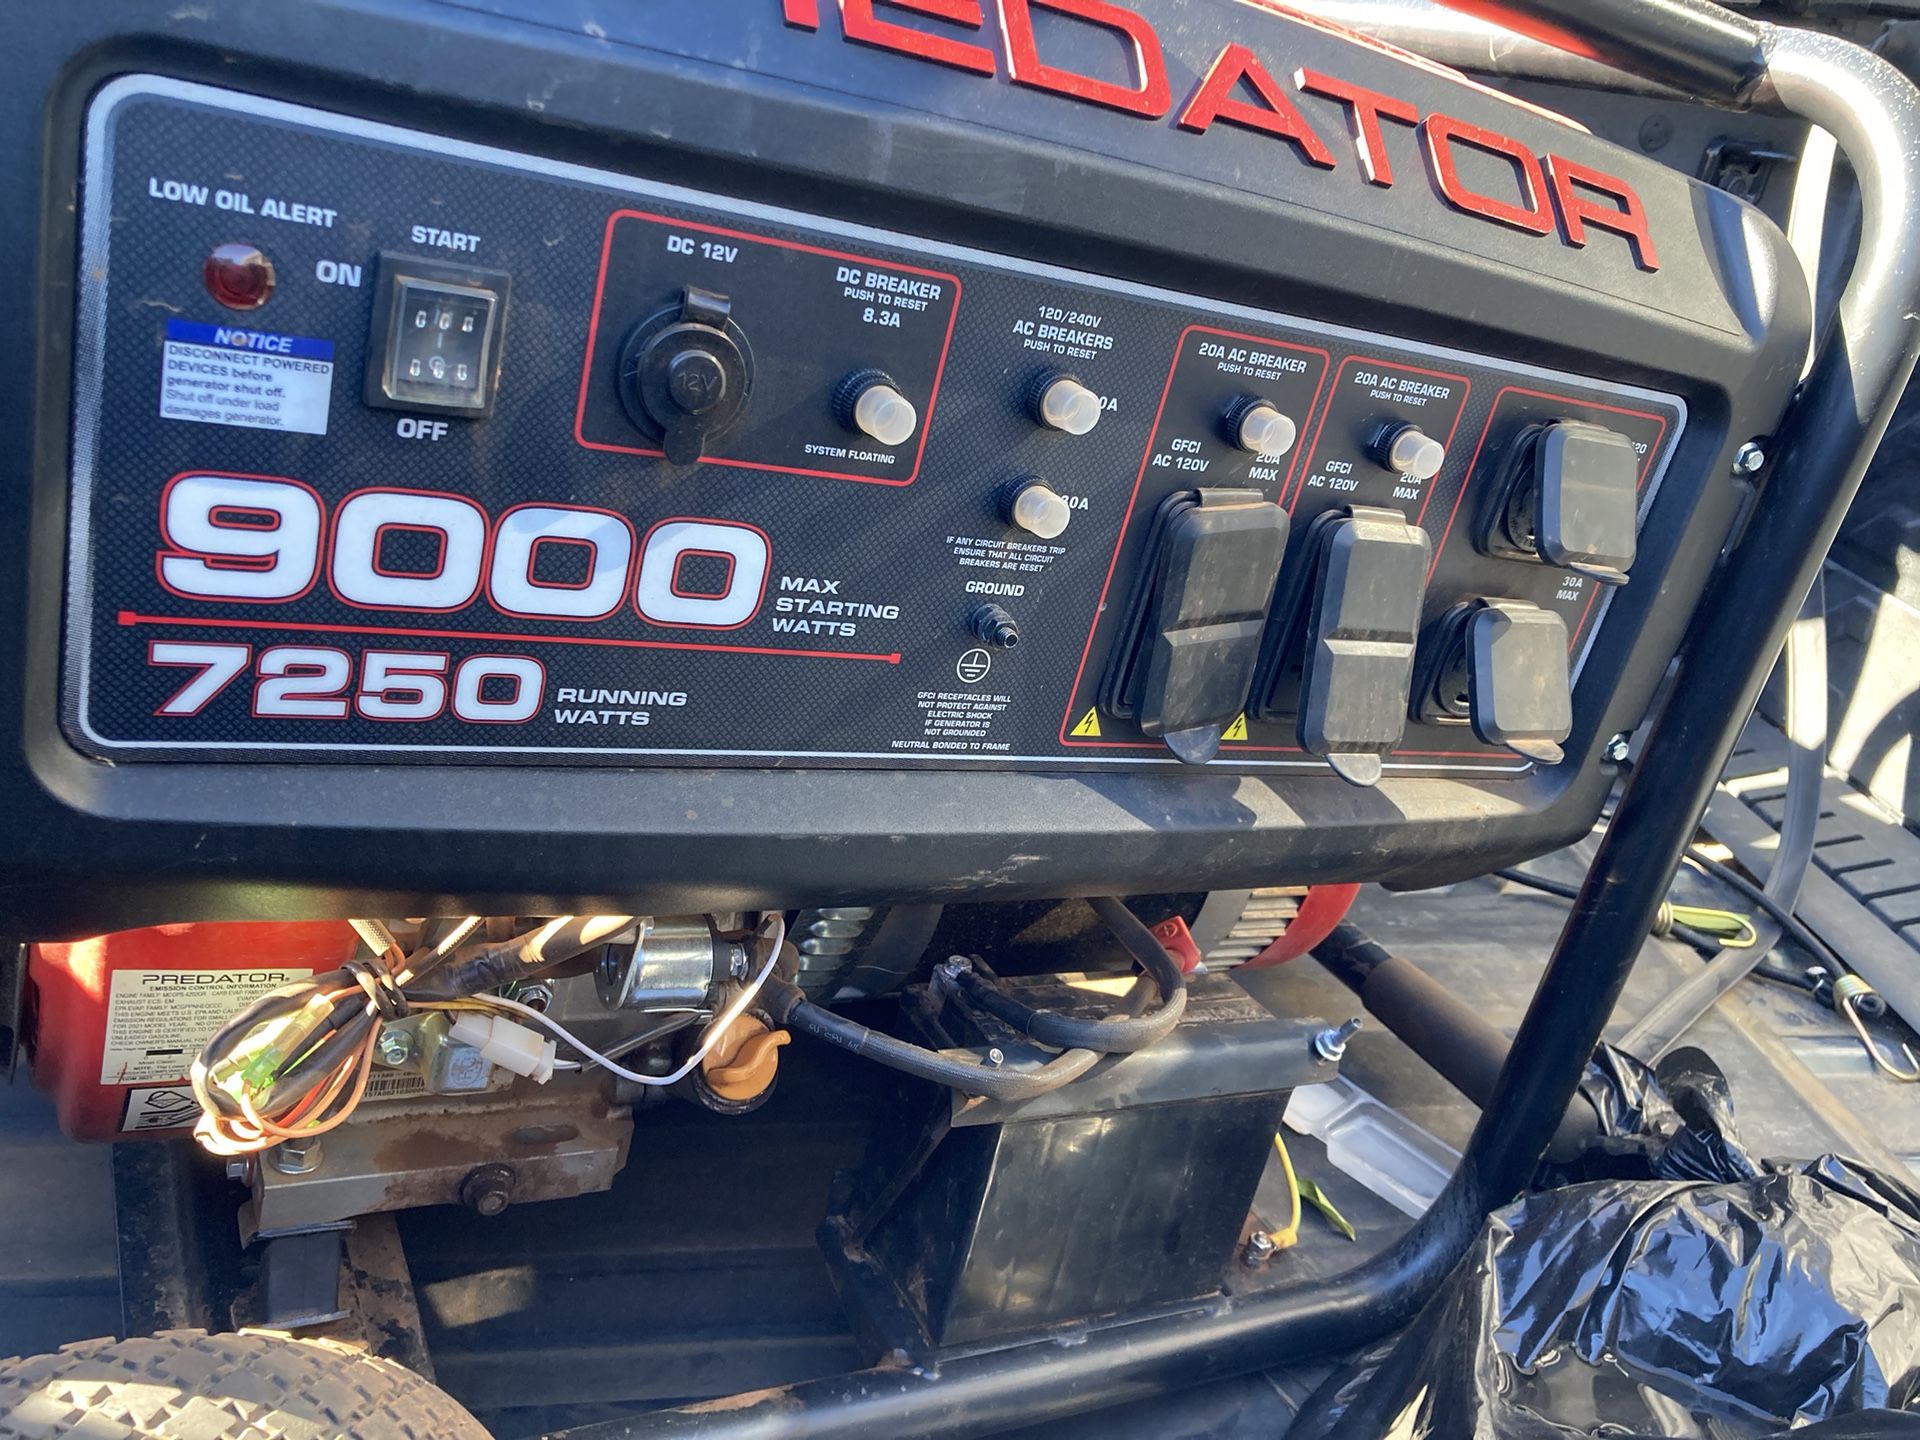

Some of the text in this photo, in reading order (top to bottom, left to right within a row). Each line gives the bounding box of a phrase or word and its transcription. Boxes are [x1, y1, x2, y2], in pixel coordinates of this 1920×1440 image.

[784, 0, 1658, 273] EDATOR
[149, 177, 337, 227] LOW OIL ALERT
[411, 225, 481, 252] START
[667, 235, 738, 263] DC 12V
[316, 260, 361, 287] ON
[836, 266, 941, 300] DC BREAKER
[844, 287, 928, 311] PUSH TO RESET
[863, 307, 900, 328] 8.3A
[1039, 306, 1102, 328] 120/240V
[214, 328, 293, 353] NOTICE
[1012, 320, 1114, 349] AC BREAKERS
[1024, 338, 1097, 360] PUSH TO RESET
[1198, 342, 1307, 373] 20A AC BREAKER
[168, 345, 329, 374] DISCONNECT POWERED
[168, 360, 272, 382] DEVICES before
[1217, 362, 1282, 380] PUSH TO RESET
[167, 376, 286, 398] generator shut off.
[678, 372, 718, 392] 12V
[1354, 371, 1450, 400] 20A AC BREAKER
[166, 390, 279, 412] Shut off under load
[1099, 396, 1118, 412] 0A
[1370, 389, 1427, 406] PUSH TO RESET
[165, 404, 221, 419] damages
[397, 418, 448, 441] OFF
[805, 444, 895, 464] SYSTEM FLOATING
[1171, 439, 1201, 454] GFCI
[1152, 454, 1210, 472] AC 120V
[1325, 461, 1352, 474] GFCI
[1248, 467, 1279, 481] MAX
[1307, 475, 1359, 491] AC 120V
[1392, 486, 1420, 500] MAX
[154, 470, 772, 632] 9000
[953, 547, 1054, 563] ENSURE THAT ALL CIRCUIT
[955, 537, 974, 546] ANY
[975, 539, 1006, 549] CIRCUIT
[1006, 542, 1047, 553] BREAKERS
[959, 557, 1044, 572] BREAKERS ARE RESET
[780, 576, 840, 594] MAX
[965, 581, 1025, 596] GROUND
[1562, 576, 1583, 588] 30A
[1556, 590, 1579, 601] MAX
[776, 597, 899, 619] STARTING
[772, 618, 856, 636] WATTS
[148, 640, 547, 724] 7250
[557, 688, 687, 706] RUNNING
[937, 692, 992, 702] RECEPTACLES
[554, 709, 650, 725] WATTS
[927, 710, 964, 718] ELECTRIC
